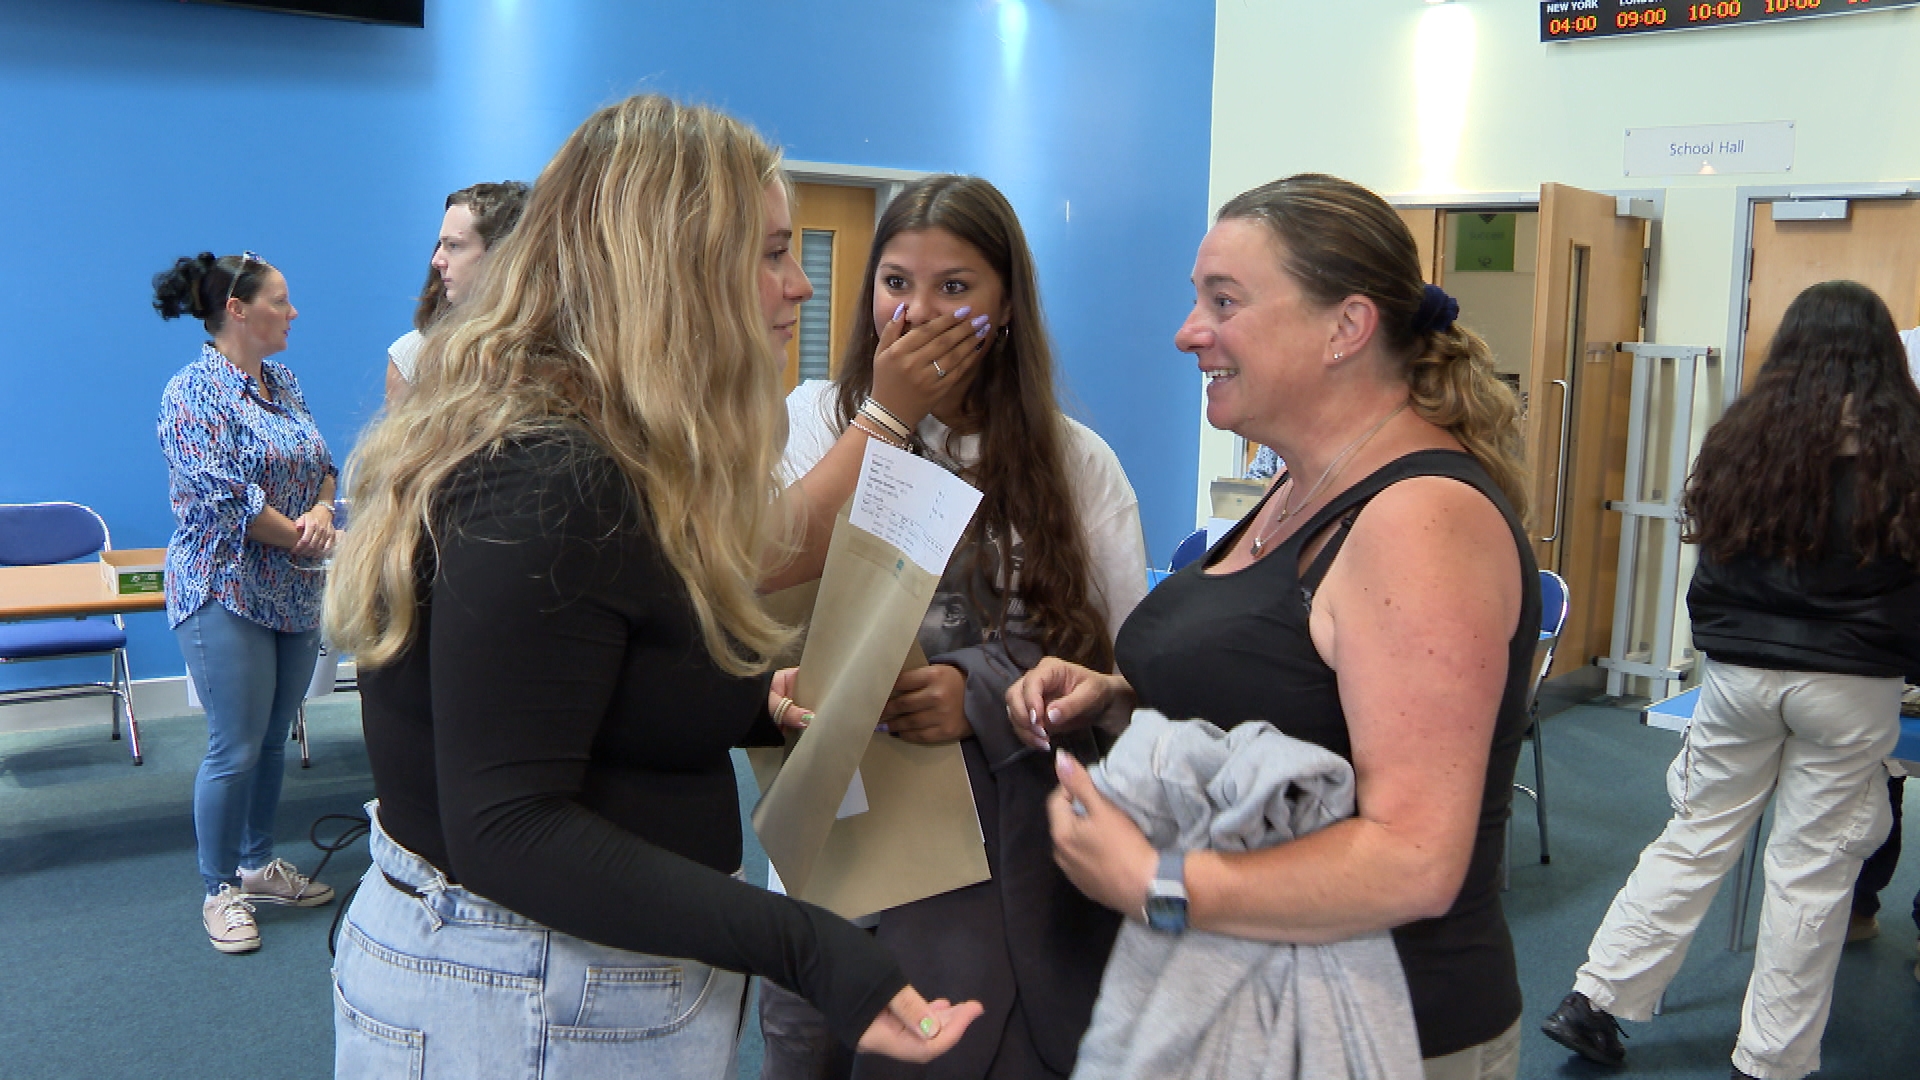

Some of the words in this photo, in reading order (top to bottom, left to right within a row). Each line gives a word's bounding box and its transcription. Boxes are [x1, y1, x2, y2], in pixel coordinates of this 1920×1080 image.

[1546, 2, 1569, 14] NEW
[1571, 0, 1599, 11] YORK
[1688, 0, 1741, 21] 10:00
[1549, 15, 1598, 35] 04:00
[1616, 8, 1666, 28] 09:00
[1670, 141, 1714, 156] School
[1719, 139, 1745, 153] Hall
